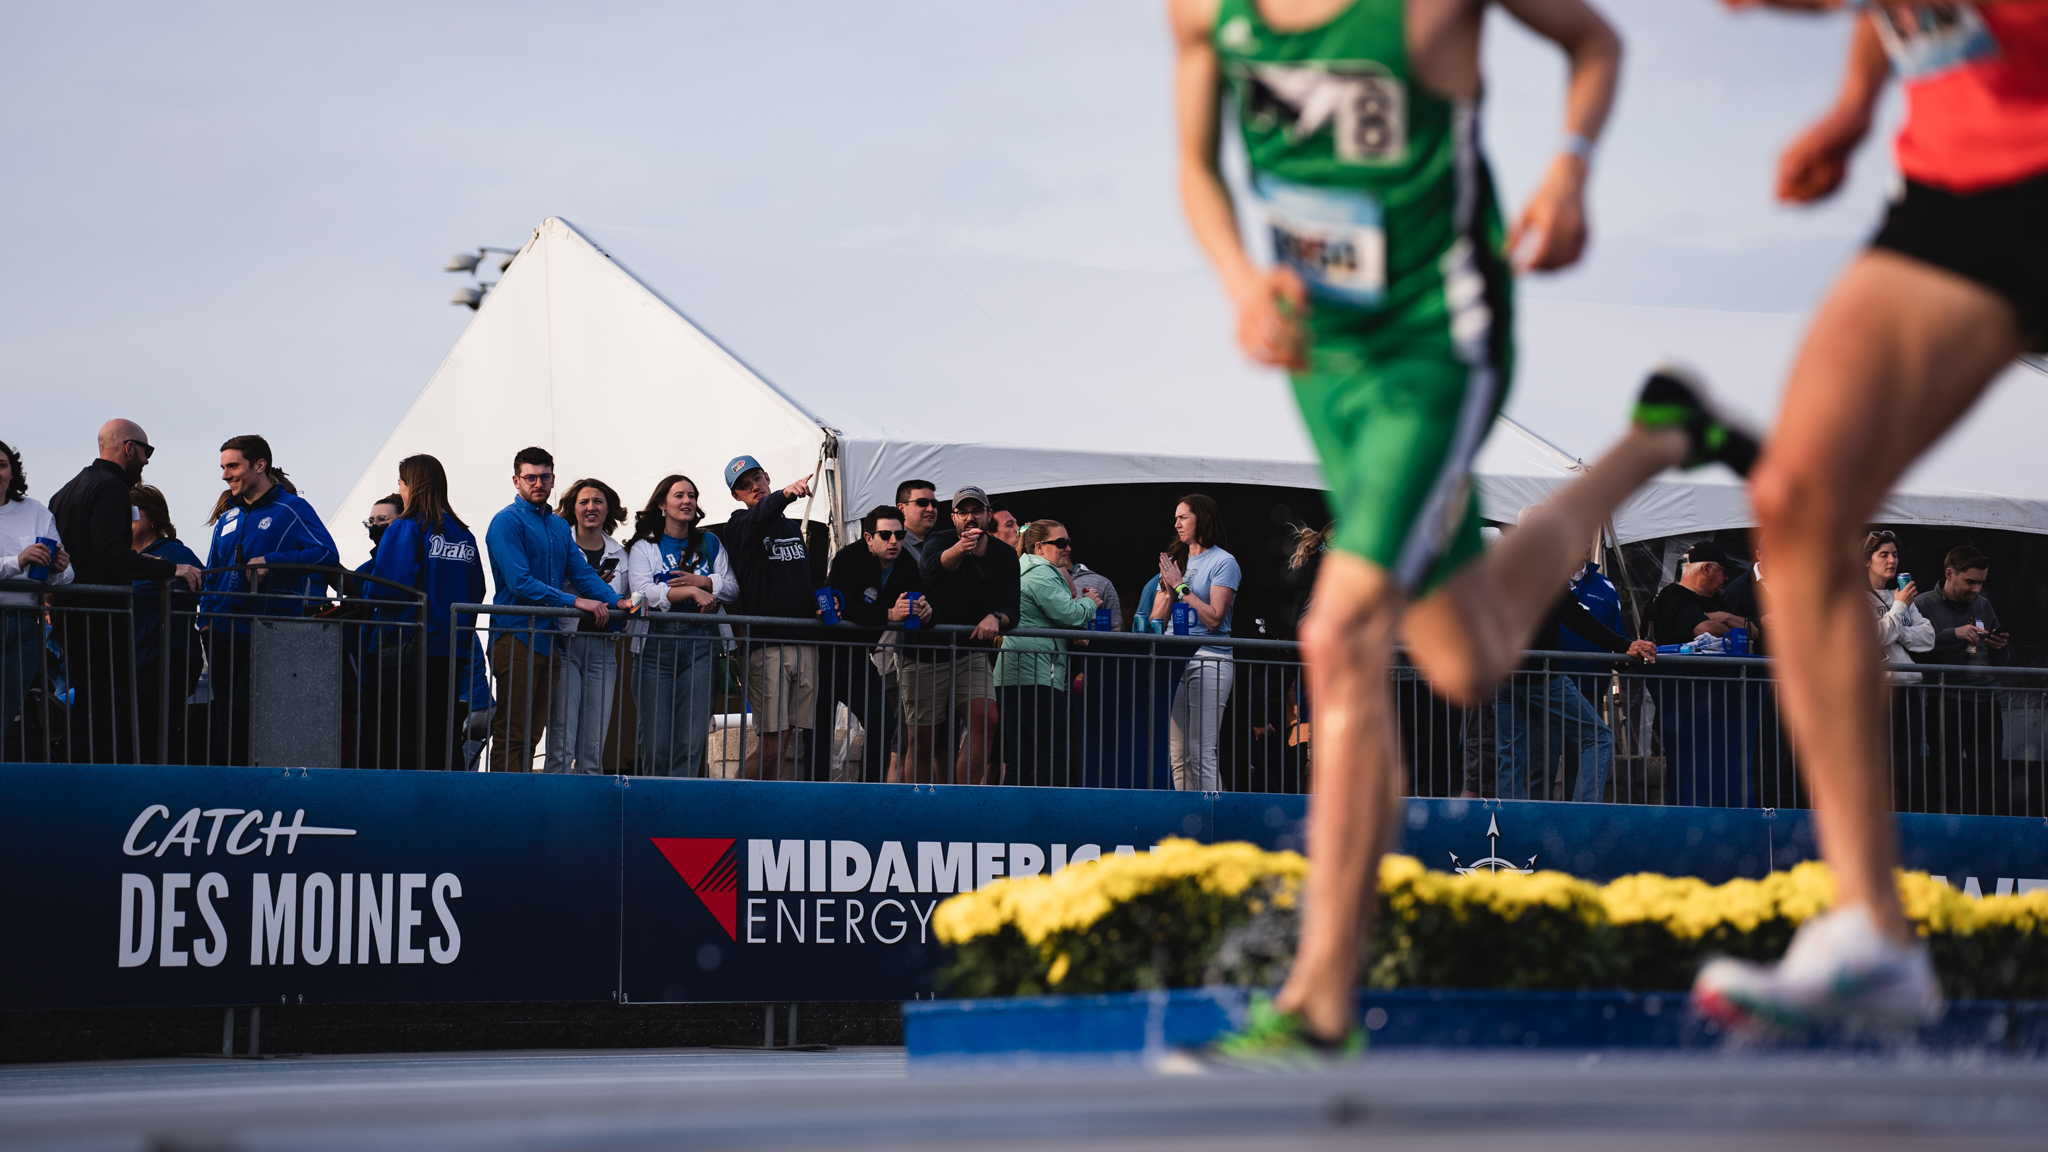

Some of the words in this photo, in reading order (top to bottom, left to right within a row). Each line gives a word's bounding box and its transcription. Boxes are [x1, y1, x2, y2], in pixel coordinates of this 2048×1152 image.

[429, 534, 475, 562] Drake
[123, 804, 357, 857] CATCH
[747, 839, 1163, 893] MIDAMERI
[118, 872, 229, 967] DES
[250, 872, 462, 966] MOINES
[747, 898, 938, 944] ENERGY
